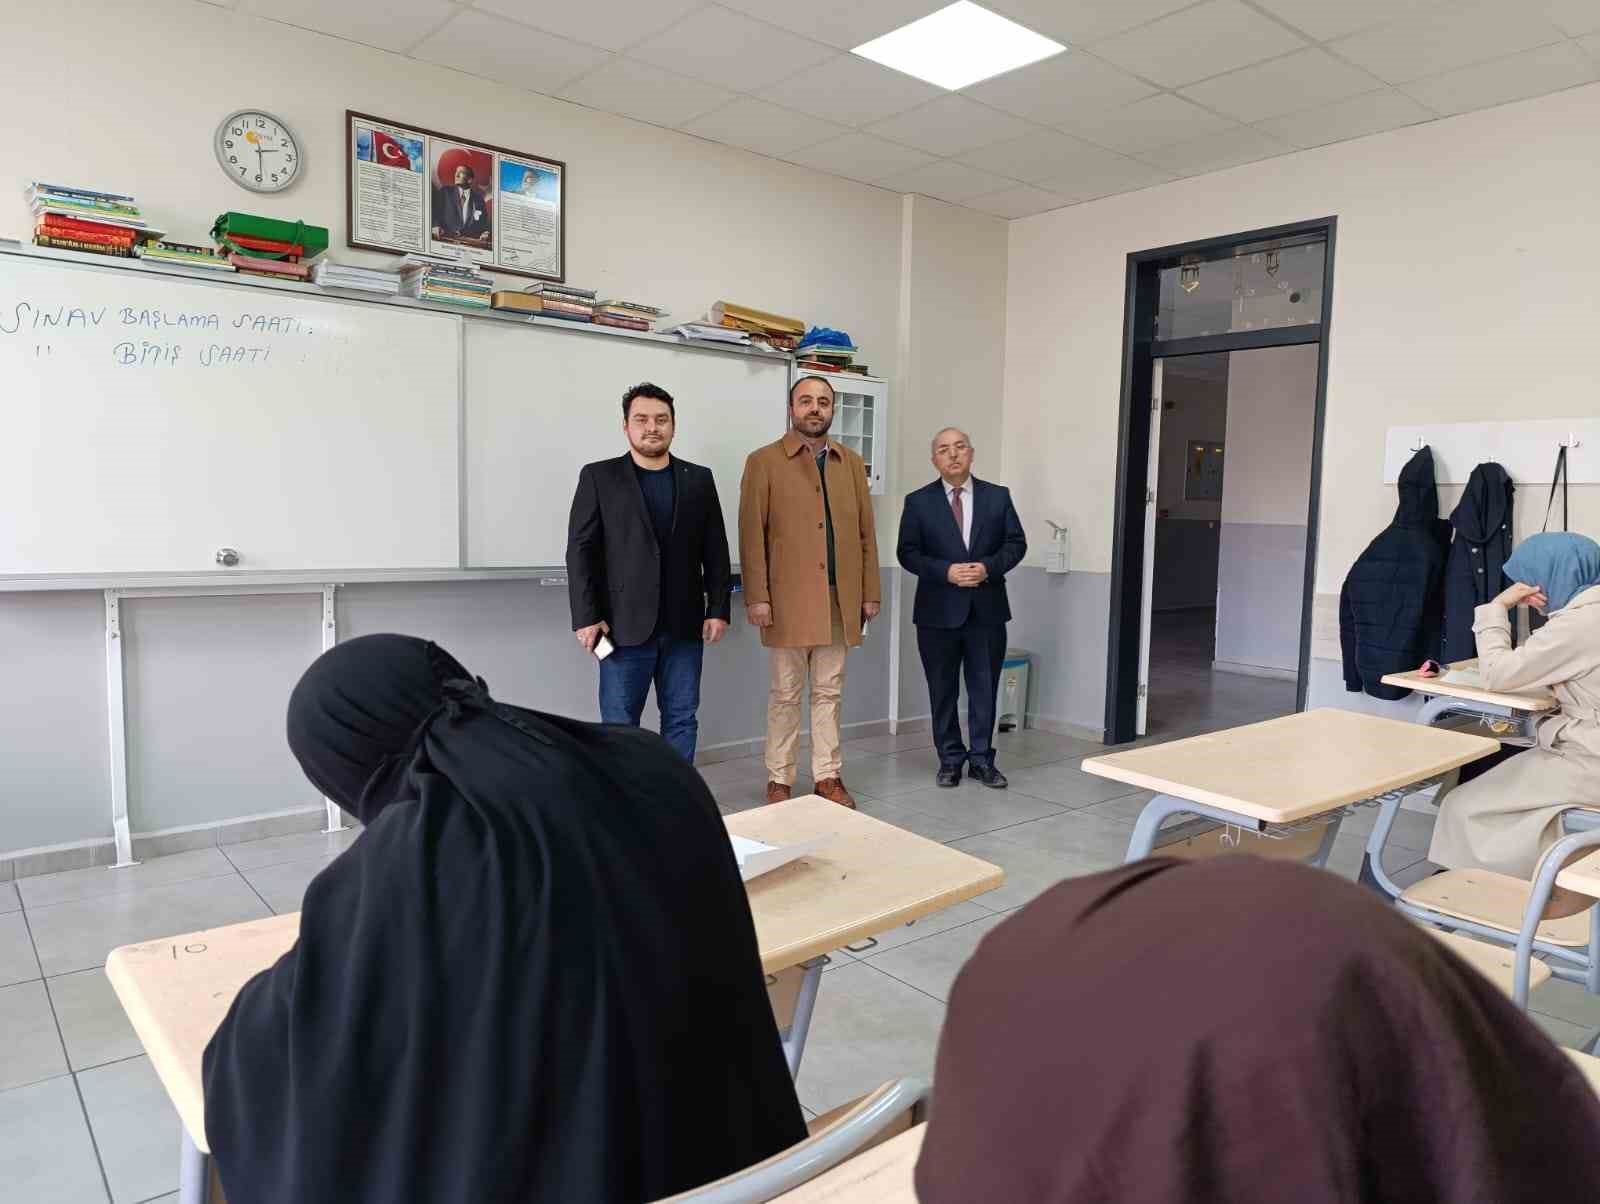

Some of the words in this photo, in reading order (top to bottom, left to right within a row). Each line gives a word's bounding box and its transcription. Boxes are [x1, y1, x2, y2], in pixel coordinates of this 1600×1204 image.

[242, 119, 249, 129] 11
[255, 118, 266, 129] 12
[231, 127, 243, 136] 10
[224, 140, 233, 149] 9
[280, 138, 288, 147] 2
[230, 155, 238, 164] 8
[286, 154, 293, 162] 3
[239, 167, 247, 176] 7
[280, 167, 288, 175] 4
[255, 174, 263, 183] 6
[271, 173, 279, 182] 5
[0, 302, 107, 334] SINAV
[119, 307, 219, 331] BAŞLAMA
